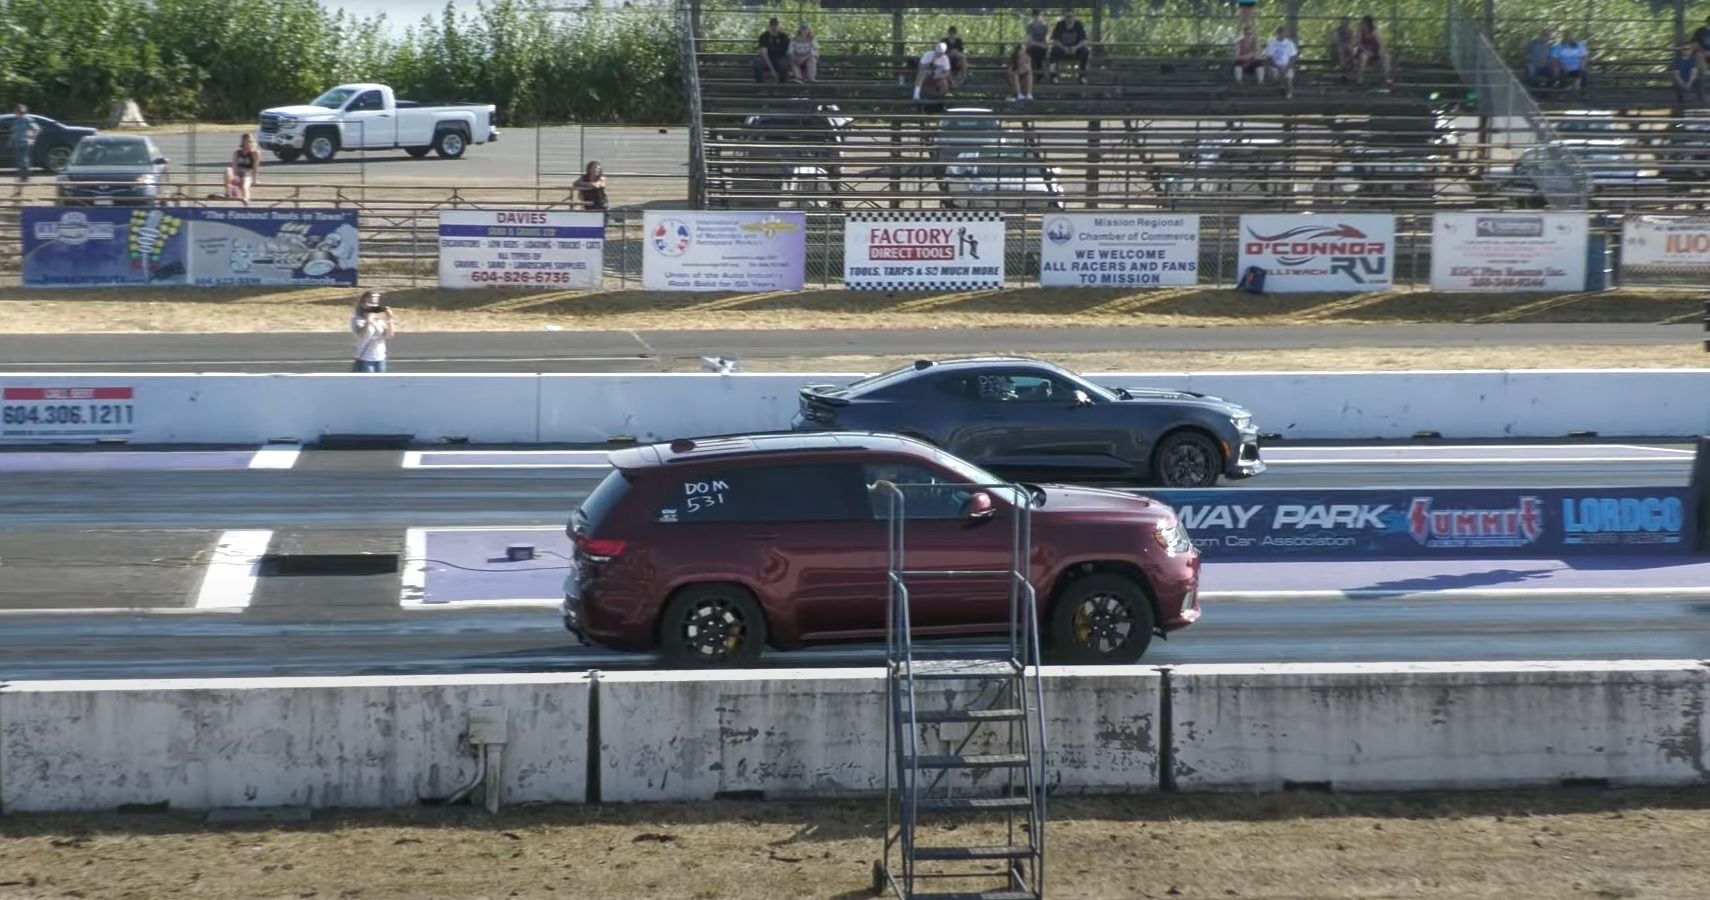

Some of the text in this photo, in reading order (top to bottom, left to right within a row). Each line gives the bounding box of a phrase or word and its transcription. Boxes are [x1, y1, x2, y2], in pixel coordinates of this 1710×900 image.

[496, 212, 547, 224] DAVIES
[1094, 218, 1184, 229] Mission Regional
[870, 228, 953, 244] FACTORY
[1079, 232, 1196, 241] Chamber of Commerce
[871, 247, 953, 258] DIRECT TOOLS
[1075, 250, 1166, 259] WE WELCOME
[1245, 242, 1386, 256] O'CONNOR
[883, 266, 914, 276] TARPS
[916, 267, 922, 276] &
[925, 266, 939, 276] SO
[940, 266, 969, 276] MUCH
[971, 266, 999, 276] MORE
[1043, 262, 1196, 271] ALL RACERS AND FANS
[1330, 257, 1386, 284] RV
[471, 271, 571, 283] 604-826-6736
[1079, 273, 1160, 284] TO MISSION
[3, 404, 134, 425] 604.306.1211
[684, 480, 729, 494] DOM
[687, 493, 724, 512] 531
[1177, 504, 1392, 529] WAY PARK
[1562, 496, 1683, 533] LORDCO
[1190, 535, 1356, 546] om Car Association
